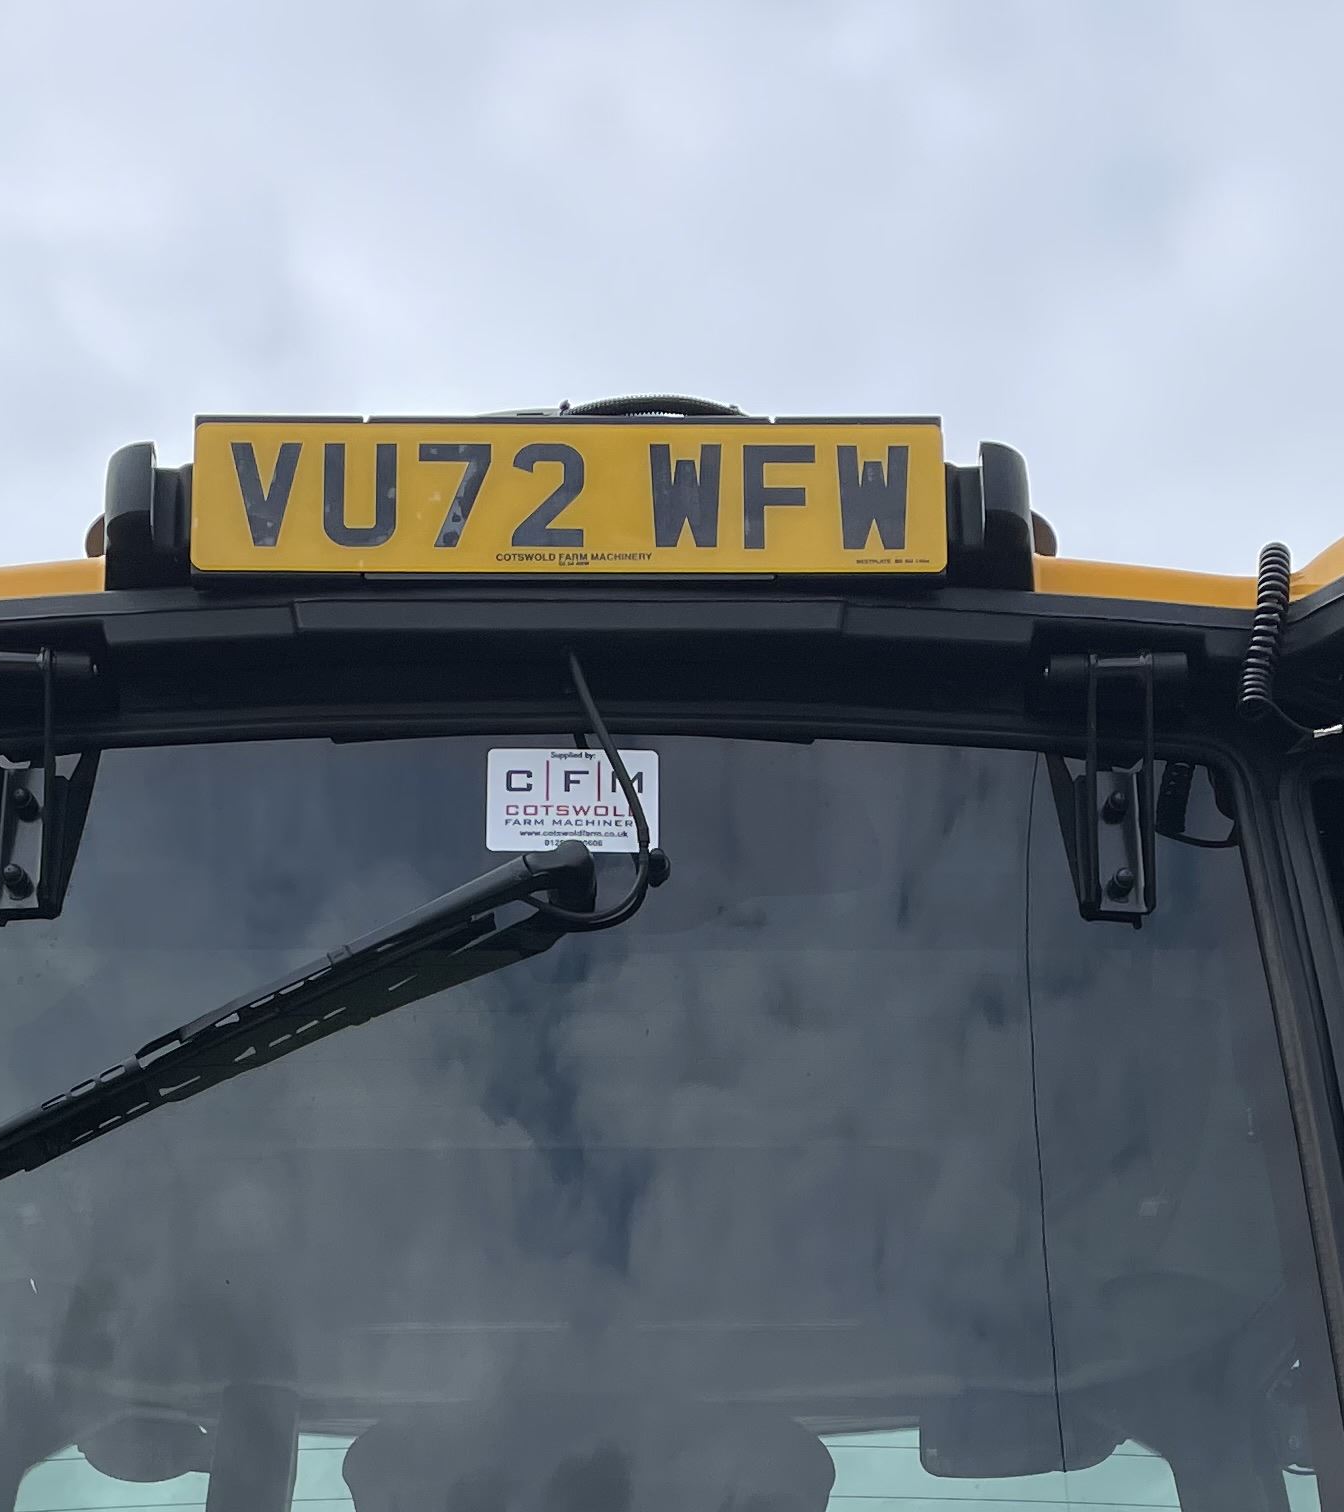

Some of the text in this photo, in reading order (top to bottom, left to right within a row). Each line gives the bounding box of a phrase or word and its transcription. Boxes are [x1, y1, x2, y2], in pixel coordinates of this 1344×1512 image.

[230, 442, 910, 550] VU72 WFW
[495, 552, 653, 562] COTSWOLD FARM MACHINERY
[550, 751, 596, 761] Supplied by:
[505, 819, 545, 827] FARM
